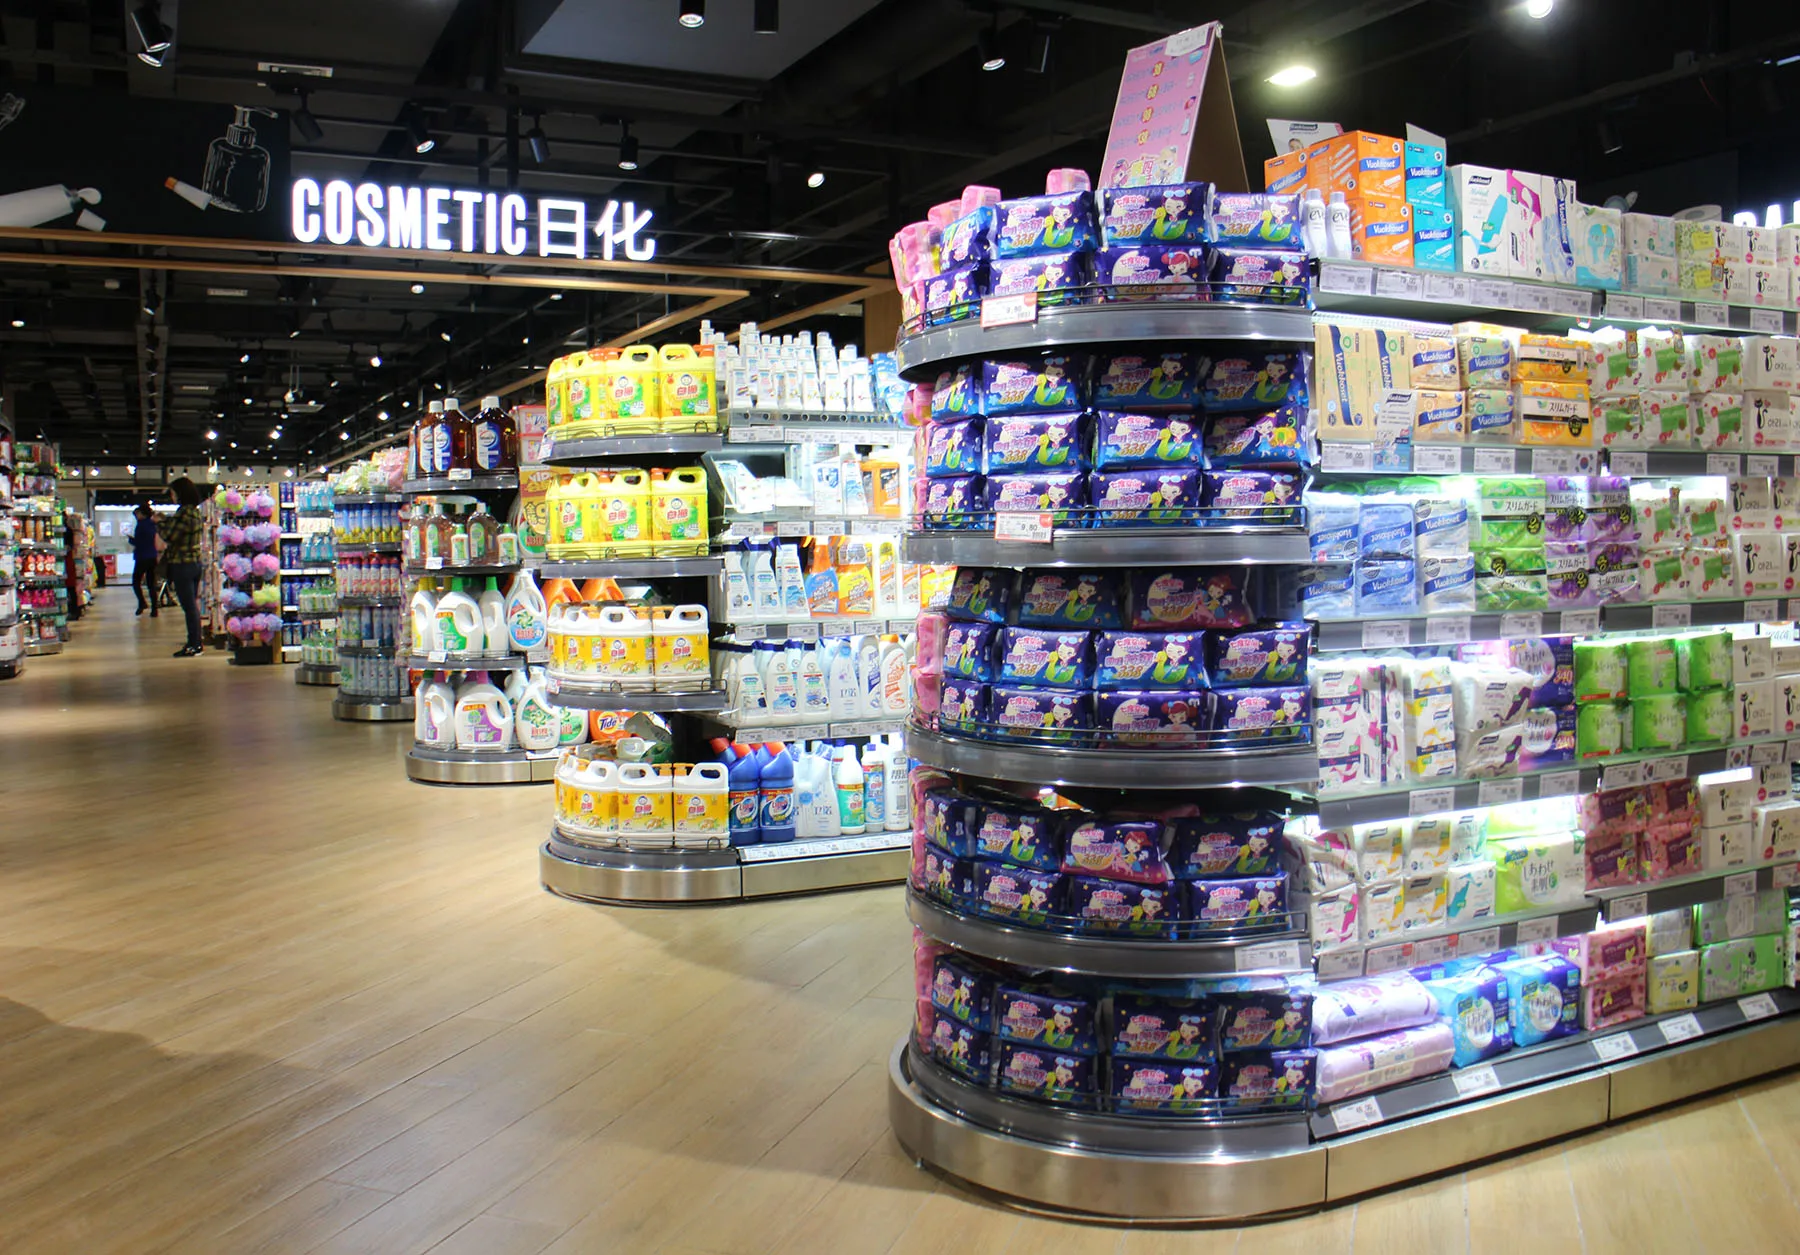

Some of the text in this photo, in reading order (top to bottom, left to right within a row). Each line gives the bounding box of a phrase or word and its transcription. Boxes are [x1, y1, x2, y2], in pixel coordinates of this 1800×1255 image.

[292, 178, 655, 261] COSMETIC 日化
[1505, 501, 1538, 511] スリムガード
[600, 716, 618, 730] Tide
